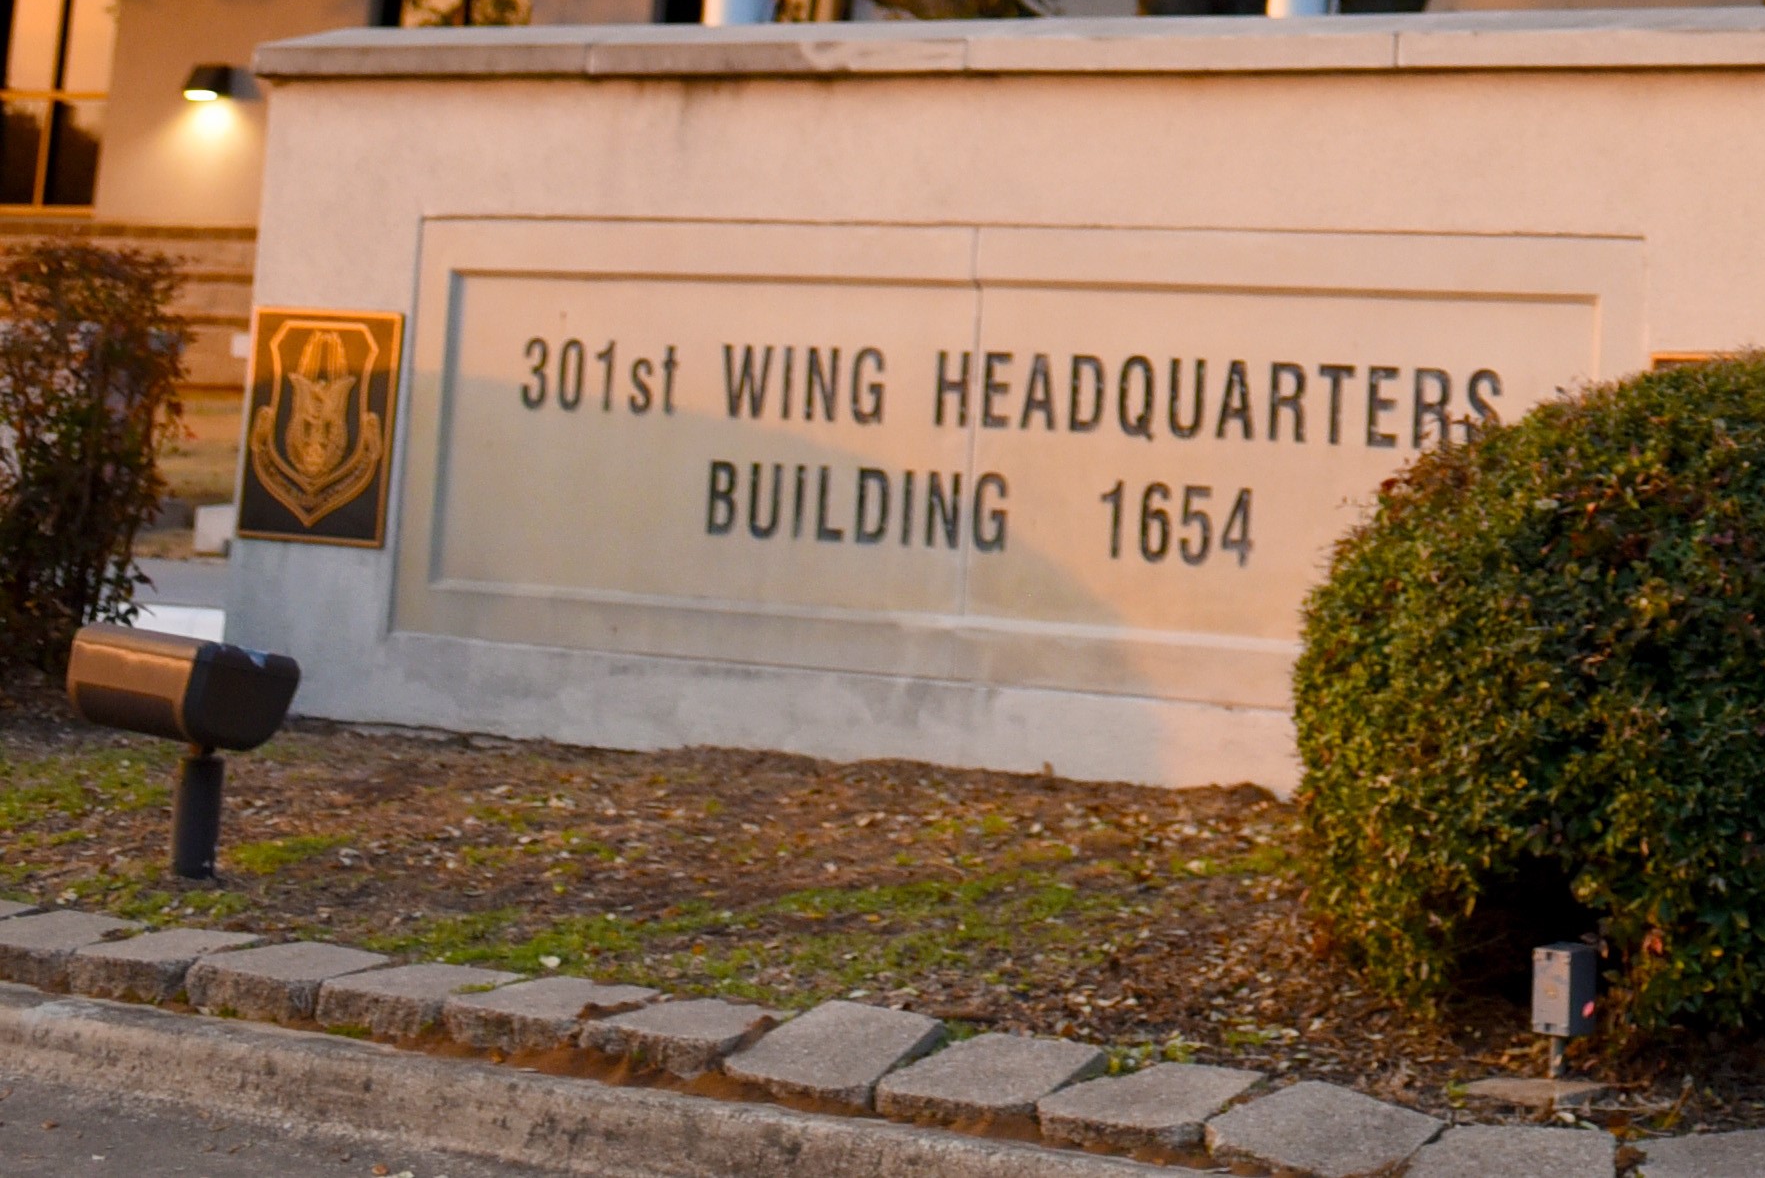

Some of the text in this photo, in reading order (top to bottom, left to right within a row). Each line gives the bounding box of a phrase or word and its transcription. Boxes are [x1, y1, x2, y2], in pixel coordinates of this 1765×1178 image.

[520, 337, 1503, 449] 301st WING HEADQUARTERS
[706, 459, 1254, 568] BUILDING 1654
